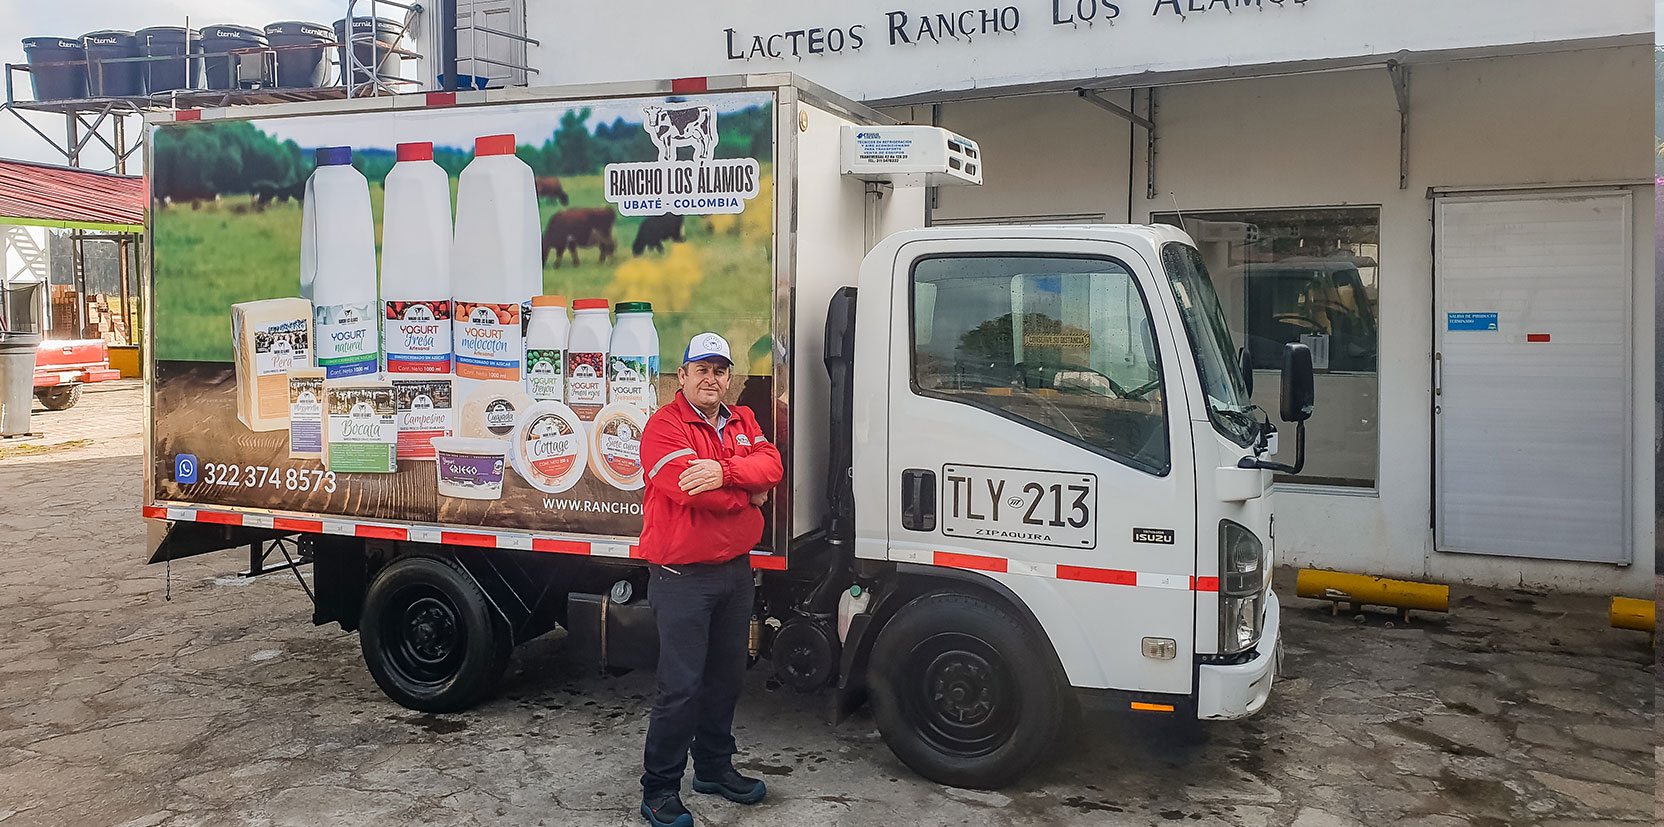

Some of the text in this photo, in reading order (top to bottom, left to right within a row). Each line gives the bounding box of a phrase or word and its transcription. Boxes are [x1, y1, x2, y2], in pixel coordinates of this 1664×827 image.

[885, 6, 1020, 45] RANCHO
[216, 30, 240, 38] Eternit
[610, 160, 754, 196] RANCHO LOS ÁLAMOS
[624, 198, 662, 210] UBATÉ
[674, 198, 738, 208] COLOMBIA
[331, 329, 366, 341] YOGURT
[400, 325, 439, 334] YOGURT
[465, 327, 504, 339] YOGURT
[335, 337, 363, 352] natural
[404, 334, 434, 347] Fresa
[404, 413, 445, 427] Campesino
[341, 420, 380, 437] Bocata
[534, 440, 569, 456] Cottage
[450, 464, 478, 475] GRIEGO
[204, 462, 337, 493] 322 374 8573
[948, 476, 1090, 528] TLY 213
[975, 528, 1052, 541] ZIPAQUIRA
[1136, 534, 1172, 542] ISUZU
